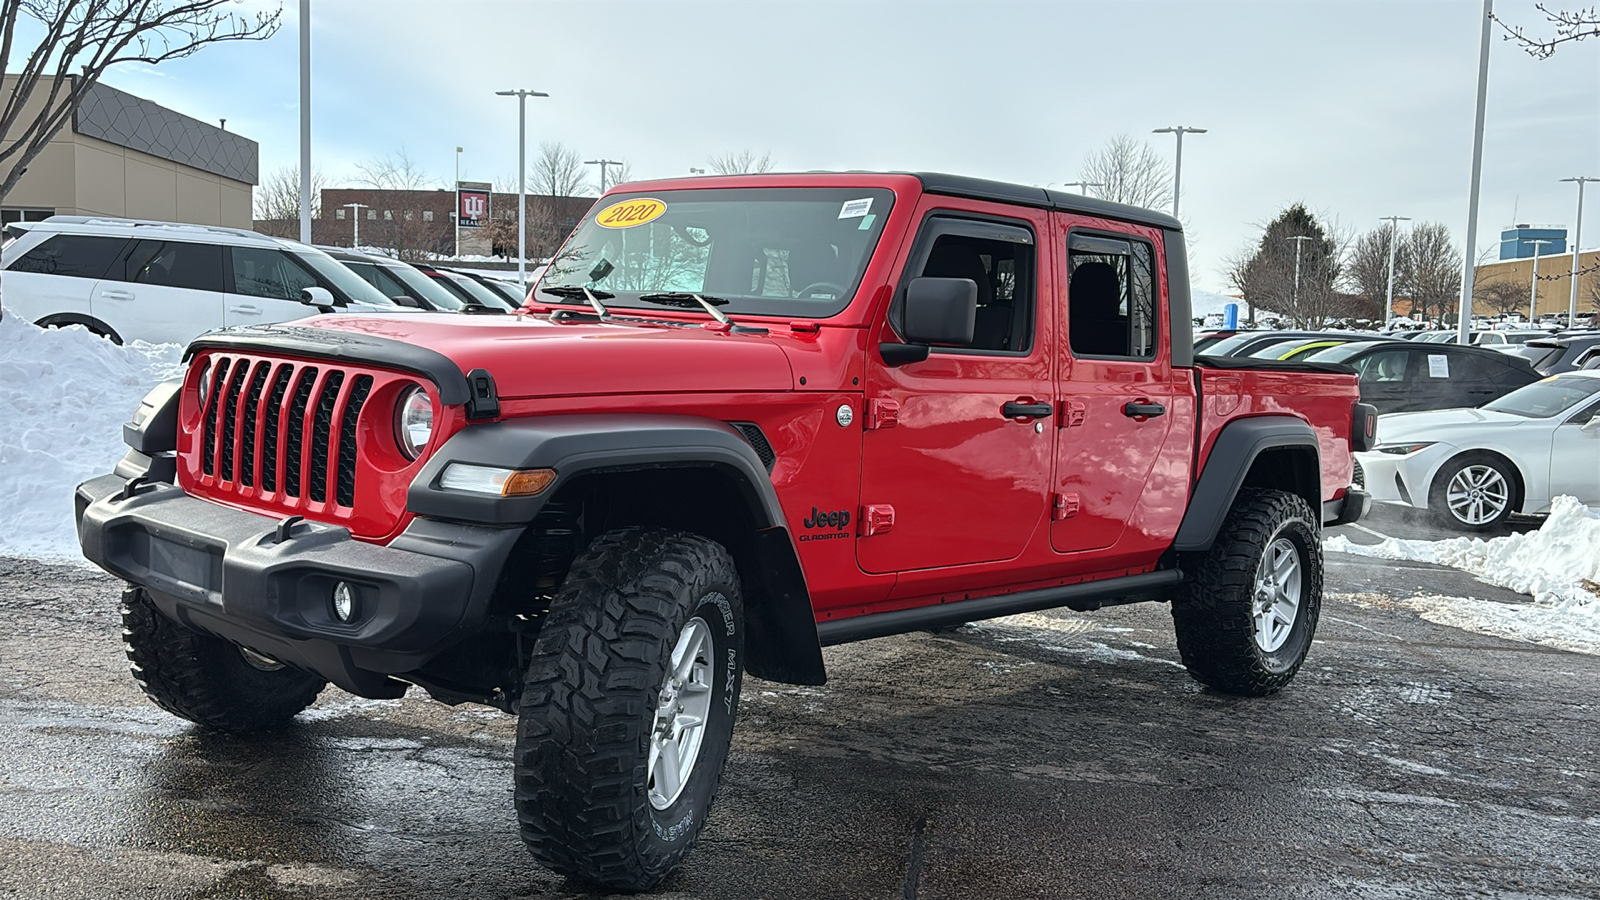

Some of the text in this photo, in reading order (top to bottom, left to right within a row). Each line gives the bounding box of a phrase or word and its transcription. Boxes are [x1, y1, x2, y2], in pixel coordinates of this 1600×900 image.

[464, 196, 484, 220] IU
[603, 203, 657, 223] 2020
[804, 506, 850, 530] Jeep
[799, 532, 850, 542] GLADIATOR
[723, 648, 736, 715] MXT
